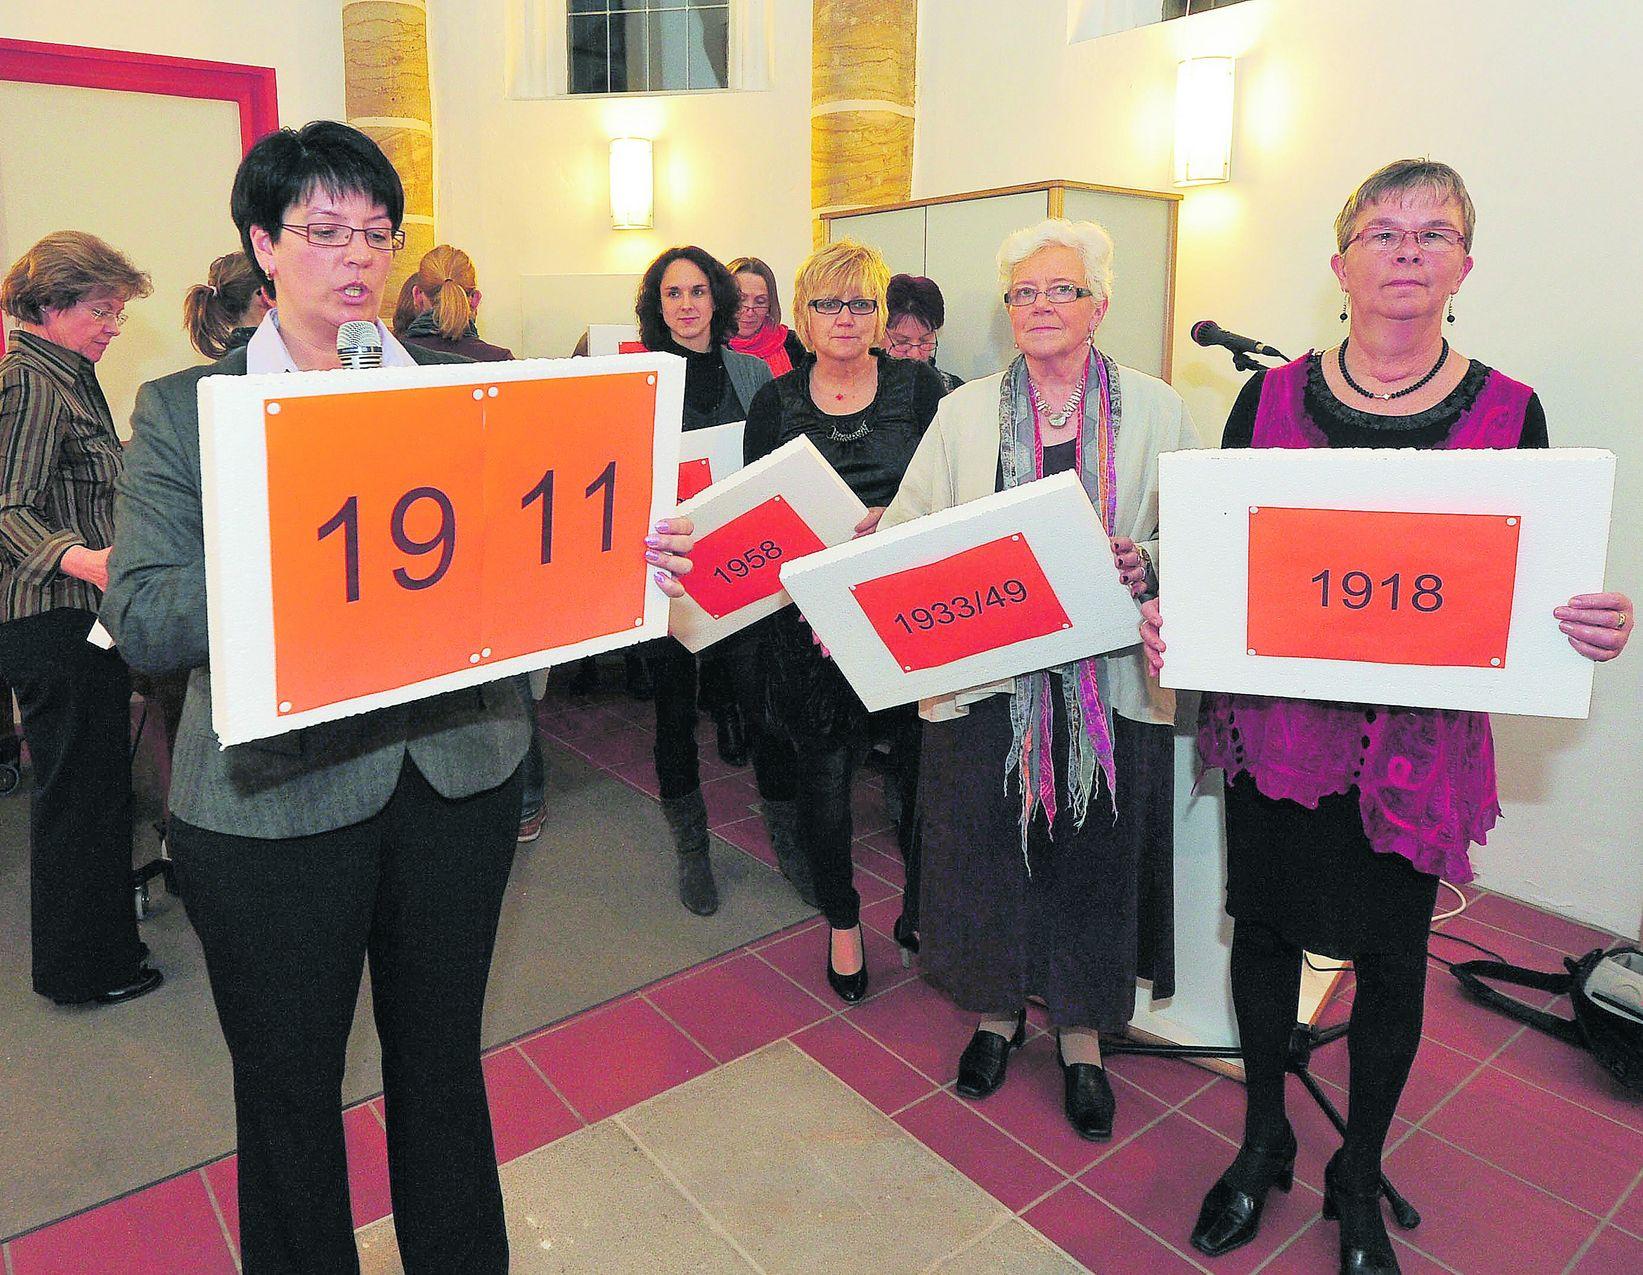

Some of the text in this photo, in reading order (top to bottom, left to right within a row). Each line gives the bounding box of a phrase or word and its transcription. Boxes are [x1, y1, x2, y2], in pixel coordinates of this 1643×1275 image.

[713, 540, 783, 584] 1958
[894, 579, 1027, 634] 1933/49
[1311, 569, 1443, 613] 1918
